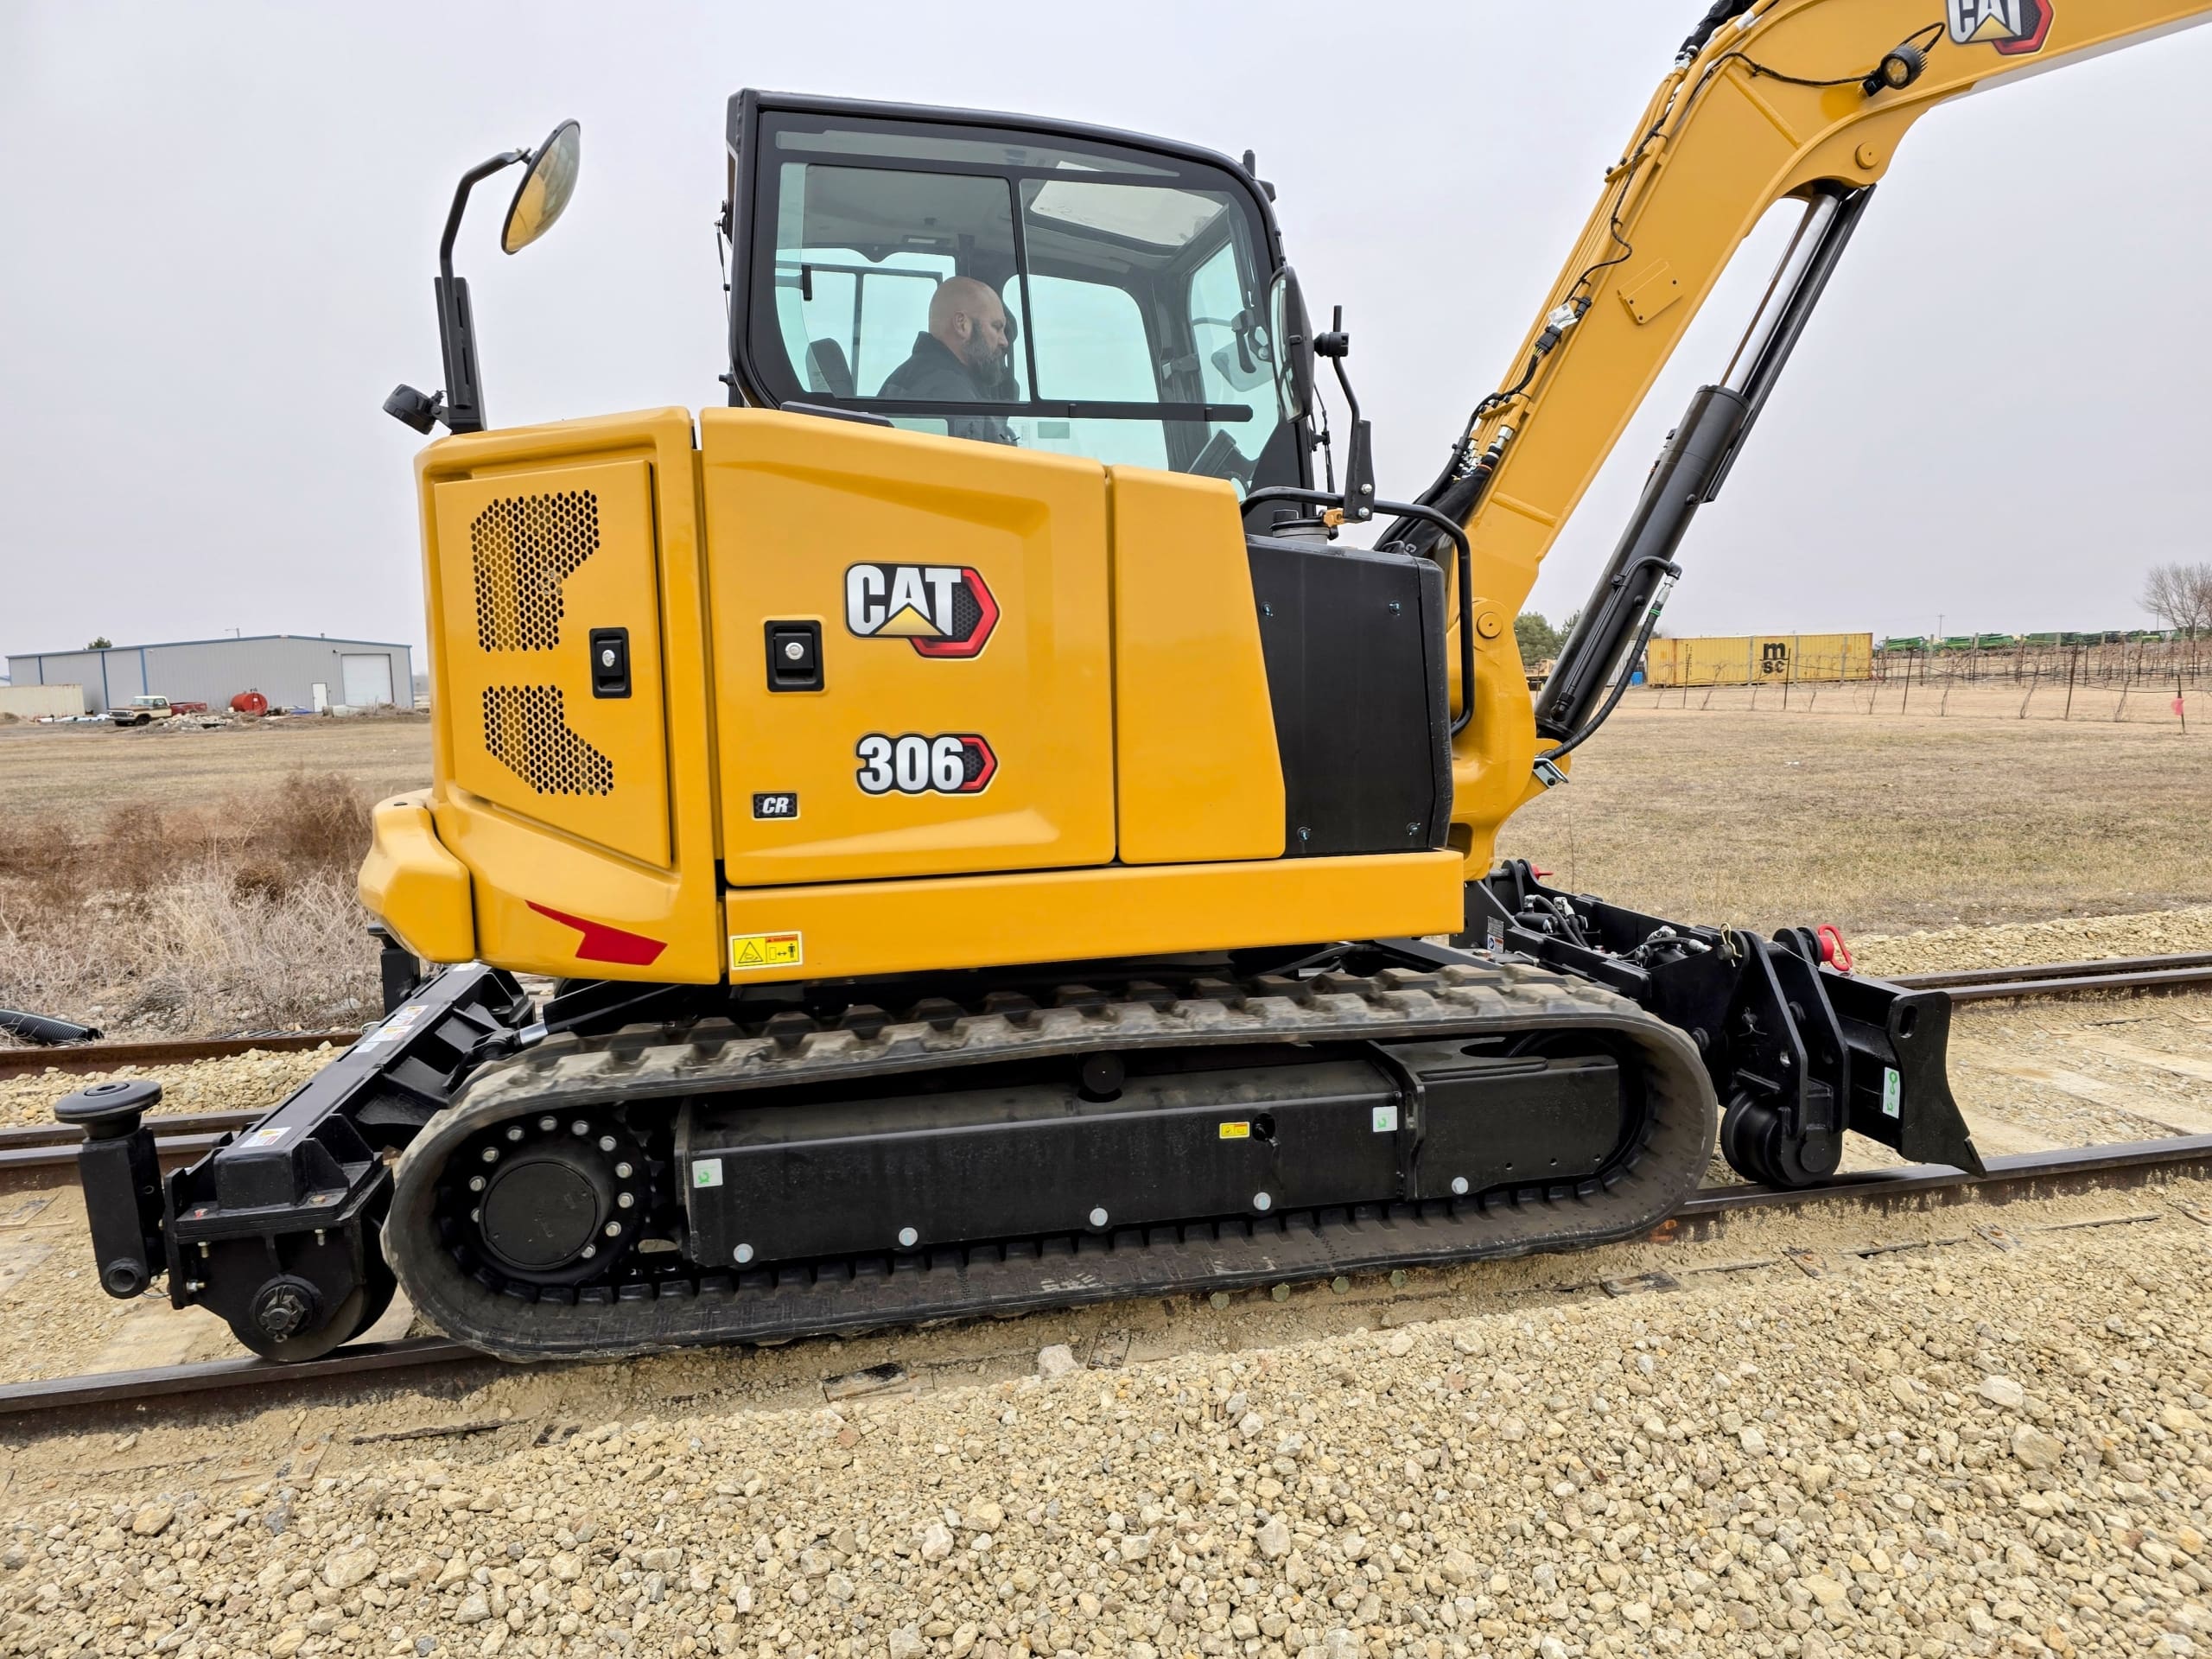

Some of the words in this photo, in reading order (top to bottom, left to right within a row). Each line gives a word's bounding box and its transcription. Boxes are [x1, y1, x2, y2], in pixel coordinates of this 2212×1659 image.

[847, 564, 962, 636] CAT
[859, 736, 964, 791] 306
[762, 797, 789, 814] CR
